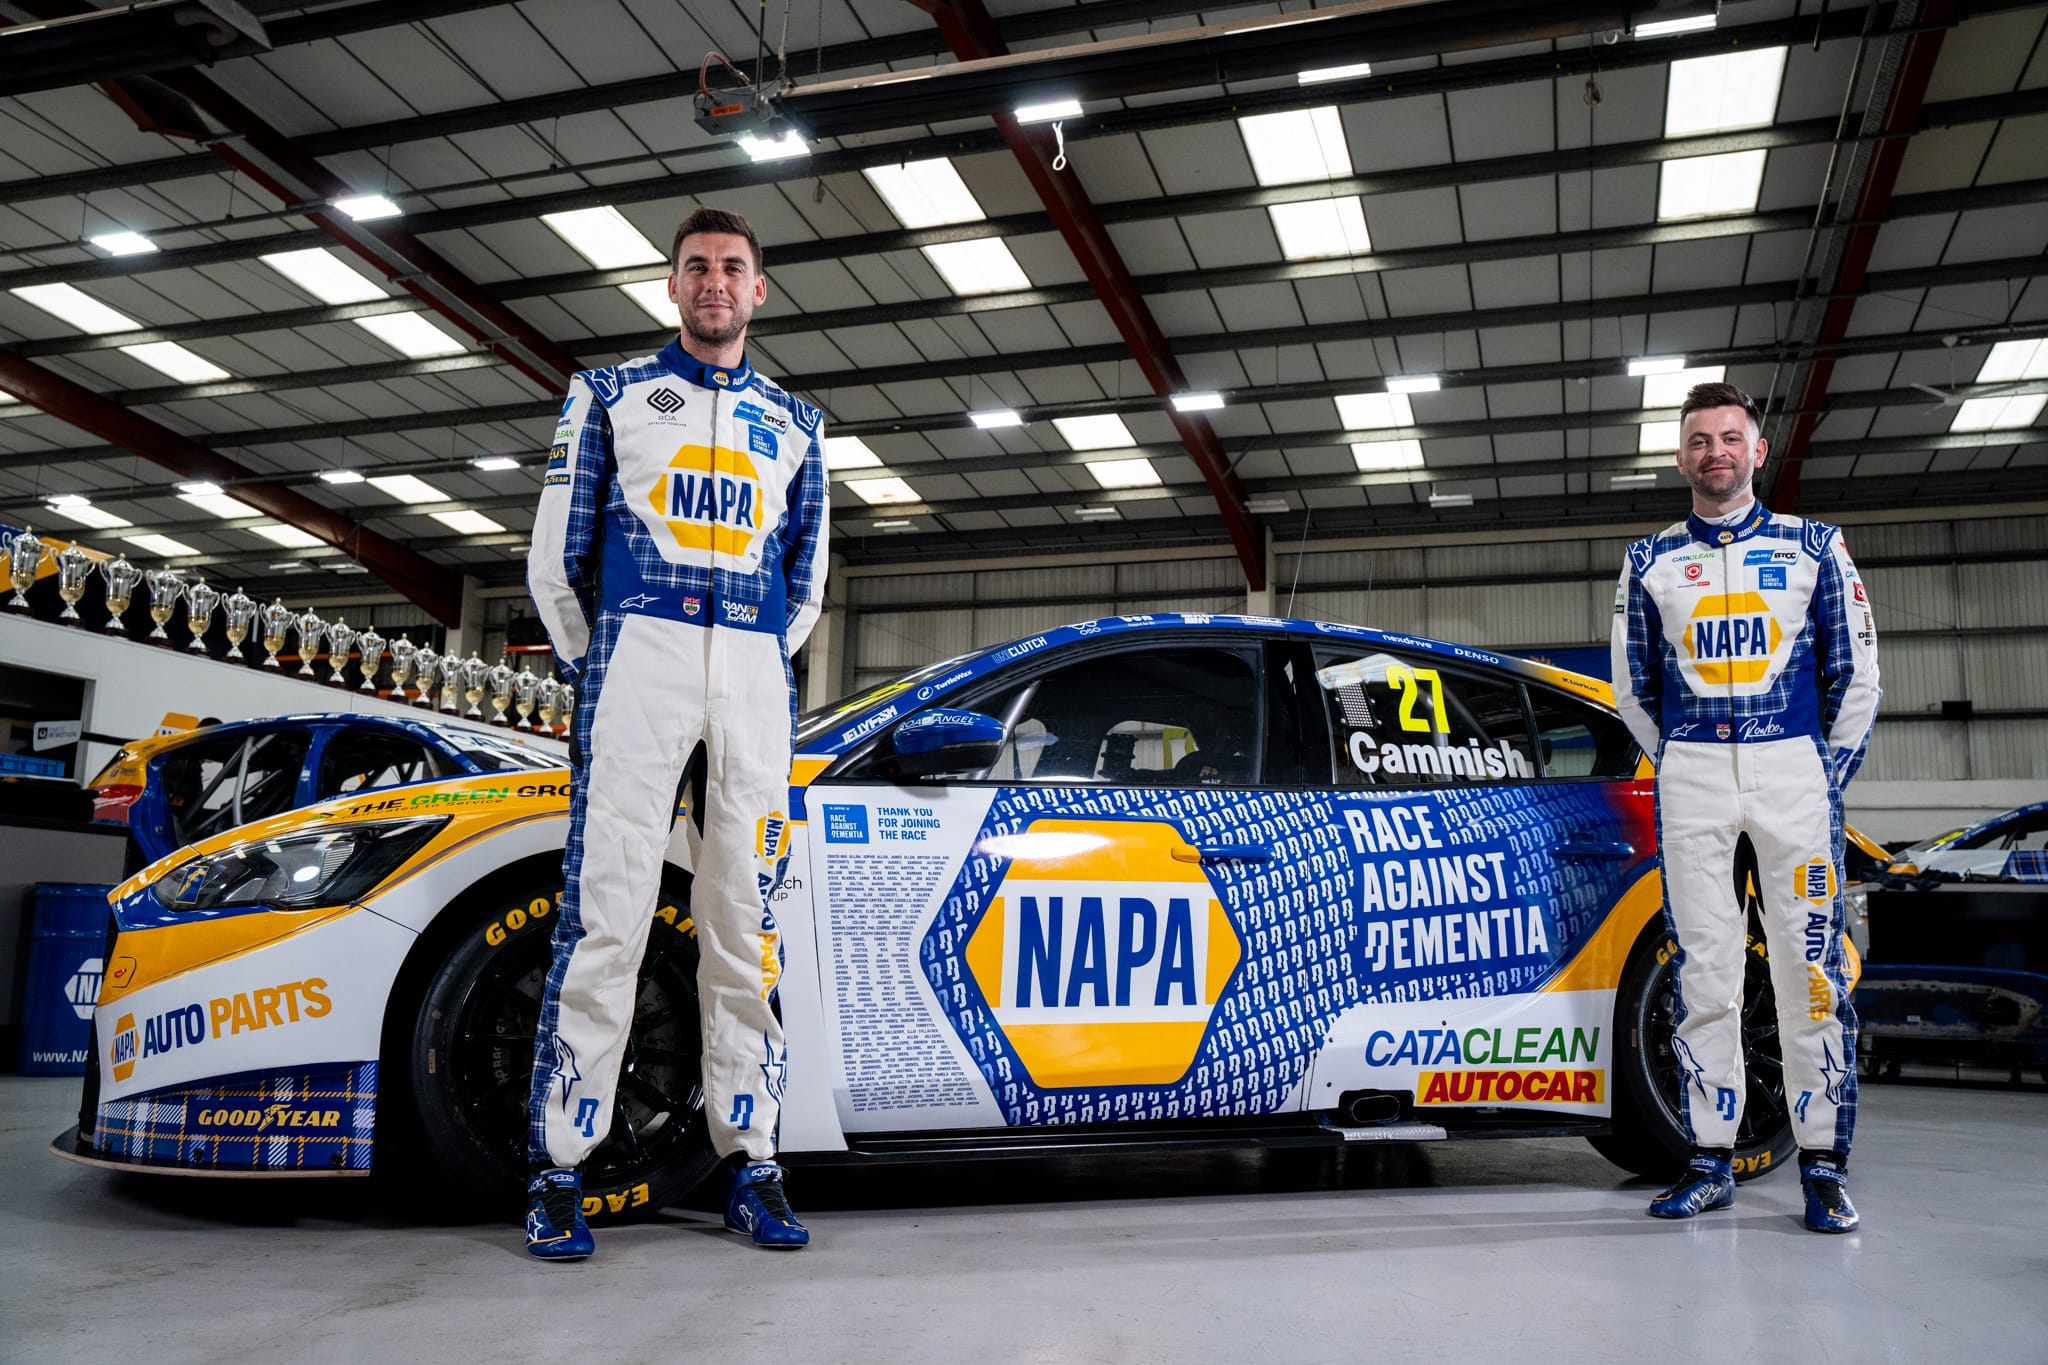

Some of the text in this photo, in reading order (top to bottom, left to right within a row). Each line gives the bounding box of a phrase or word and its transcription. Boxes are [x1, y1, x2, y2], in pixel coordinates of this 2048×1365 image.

[671, 473, 754, 529] NAPA
[1672, 552, 1715, 563] CATACLEAN
[1774, 552, 1797, 560] BTCC
[727, 610, 758, 625] CAM
[1382, 634, 1433, 649] nexdrive
[1696, 617, 1767, 660] NAPA
[1454, 648, 1499, 665] DENSO
[1385, 665, 1451, 734] 27
[842, 705, 898, 745] JELLYFISH
[1349, 731, 1531, 779] Cammish
[349, 798, 406, 815] THE
[410, 787, 509, 806] GREEN
[447, 799, 504, 808] Service
[877, 807, 933, 817] THANK YOU
[830, 814, 846, 822] RACE
[830, 822, 857, 830] AGAINST
[831, 830, 863, 839] DEMENTIA
[878, 818, 940, 828] FOR JOINING
[1343, 805, 1443, 854] RACE
[764, 818, 783, 857] NAPA
[879, 830, 927, 840] THE RACE
[1362, 852, 1509, 913] AGAINST
[1808, 865, 1827, 898] NAPA
[485, 891, 564, 947] GOO
[1015, 896, 1198, 1008] NAPA
[1363, 905, 1549, 973] DEMENTIA
[1804, 911, 1832, 1022] AUTO PARTS
[113, 977, 332, 1064] NAPA AUTO PARTS
[1364, 1026, 1600, 1067] CATACLEAN
[1423, 1071, 1597, 1103] AUTOCAR
[1732, 1150, 1772, 1174] EAG
[582, 1183, 649, 1217] EAG
